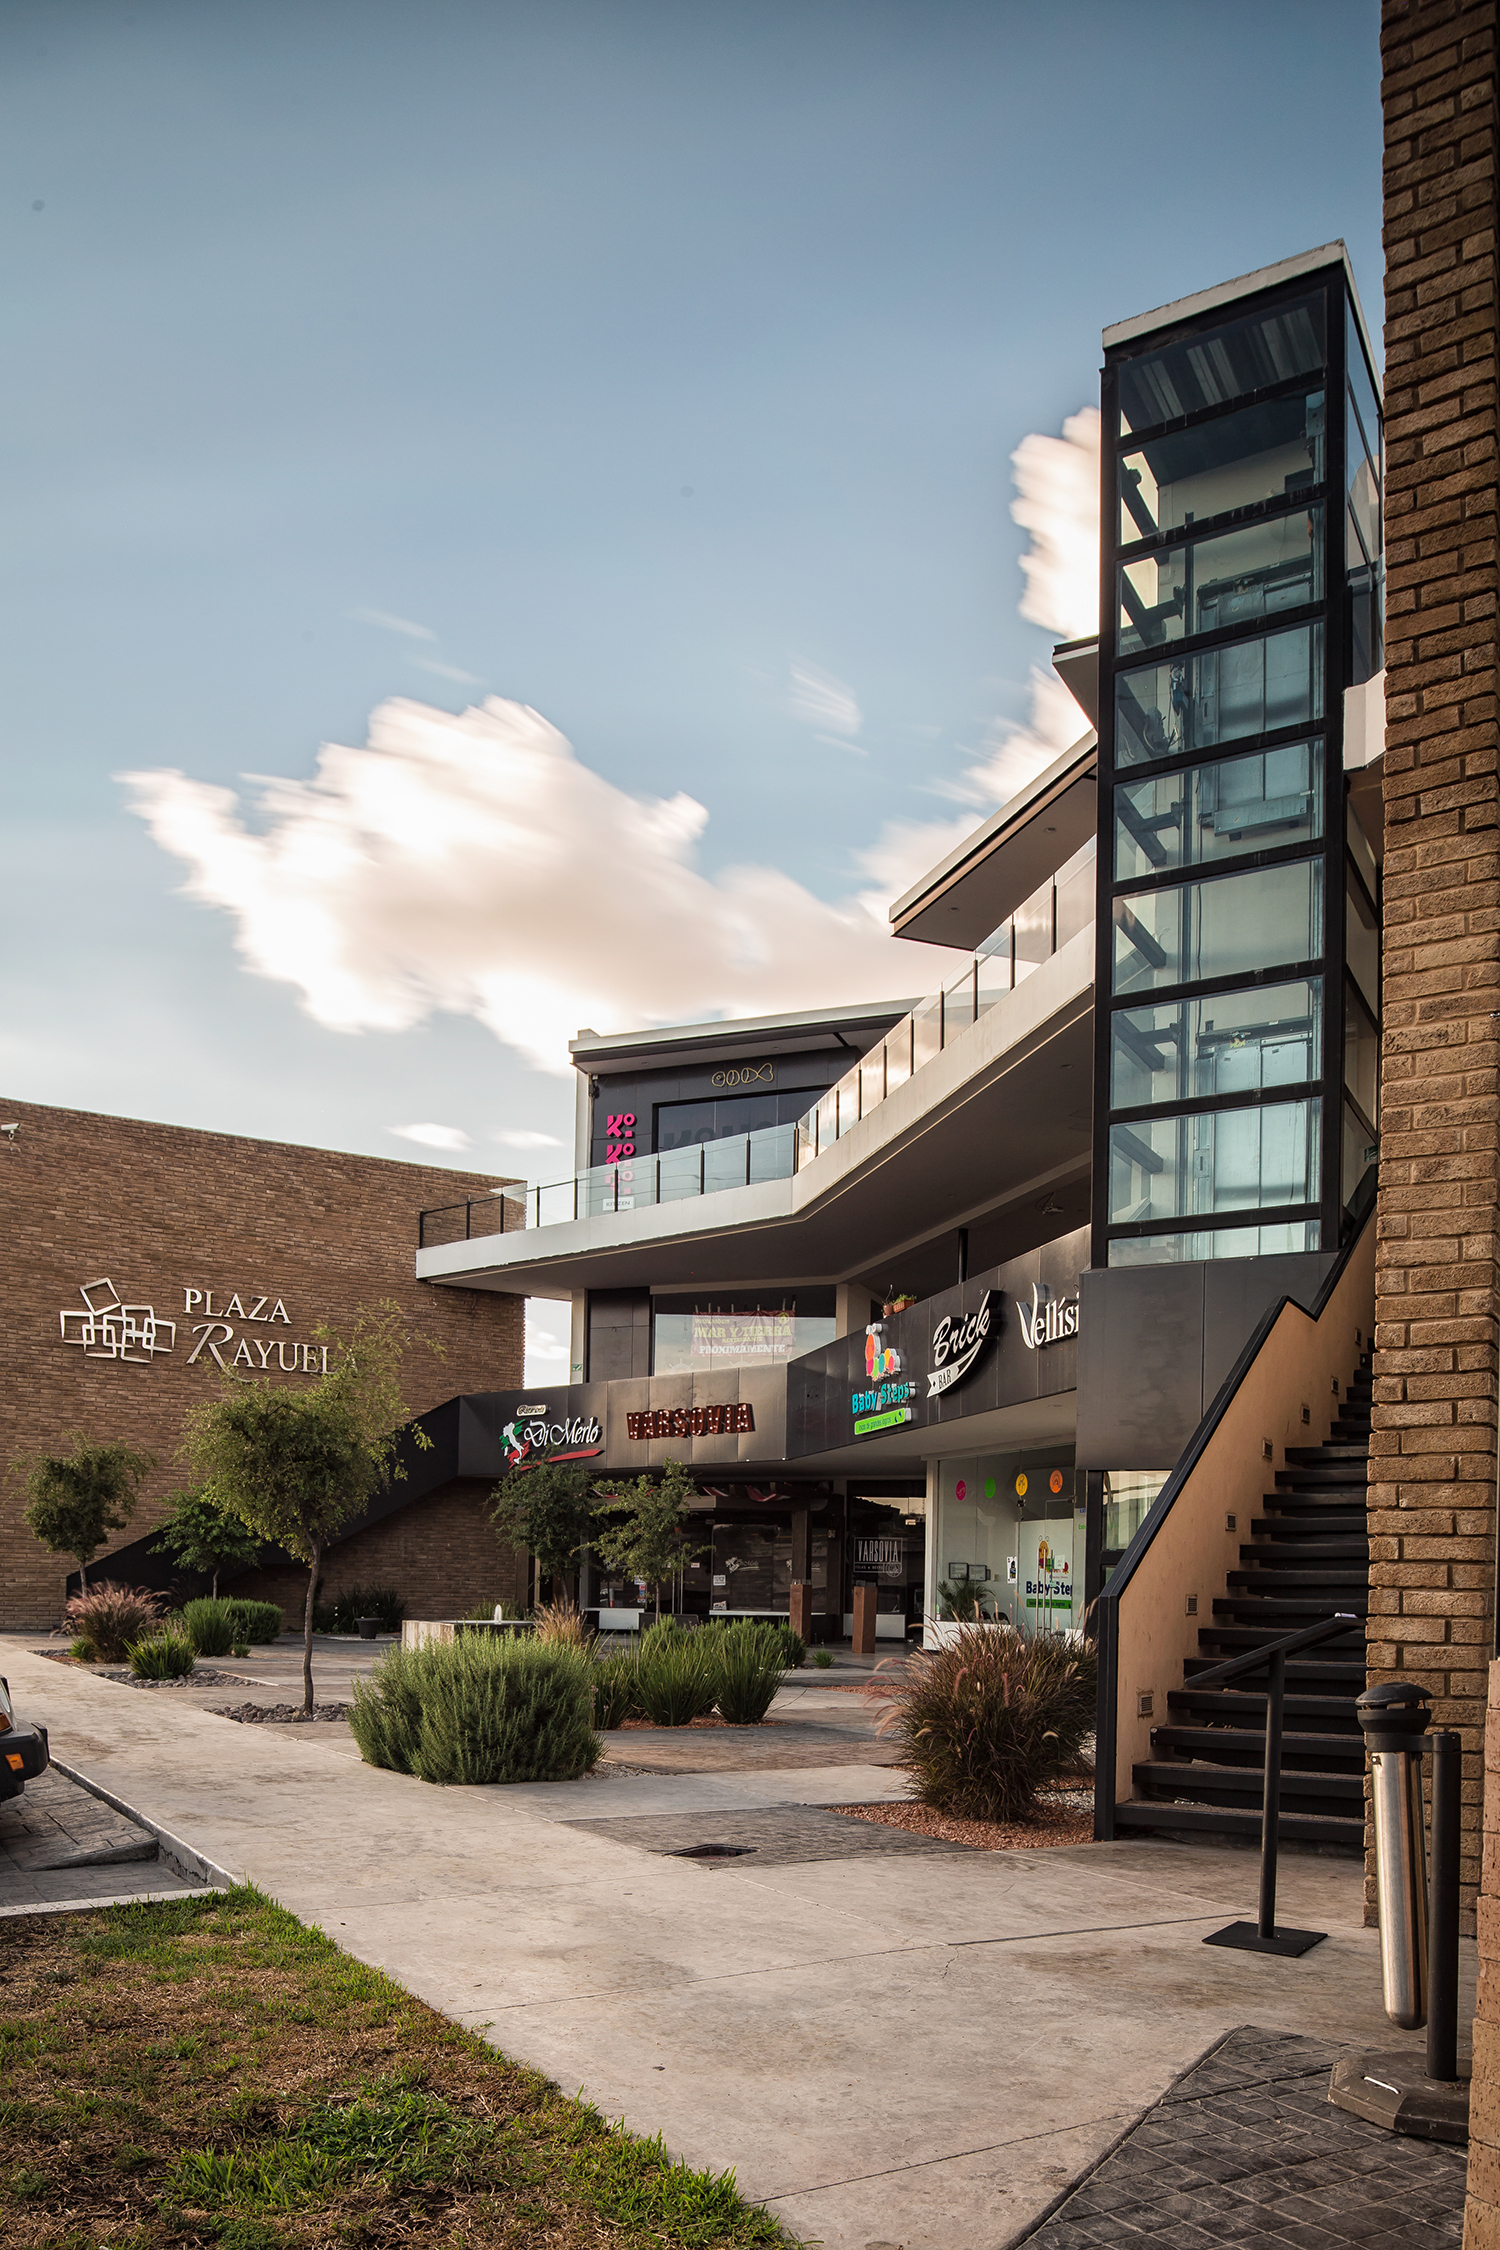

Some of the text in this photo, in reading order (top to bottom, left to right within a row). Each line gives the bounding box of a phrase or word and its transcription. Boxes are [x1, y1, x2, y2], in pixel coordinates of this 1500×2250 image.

[182, 1287, 292, 1324] PLAZA
[694, 1325, 792, 1338] MAR Y TIERRA
[933, 1290, 990, 1366] Brick
[699, 1344, 786, 1354] PROXIMAMENTE
[938, 1369, 952, 1389] BAR
[852, 1382, 910, 1414] Baby Steps
[523, 1417, 600, 1447] Di Merlo
[627, 1403, 752, 1440] VARSOVIA
[858, 1540, 899, 1562] VARSOVIA
[1026, 1581, 1051, 1596] Baby
